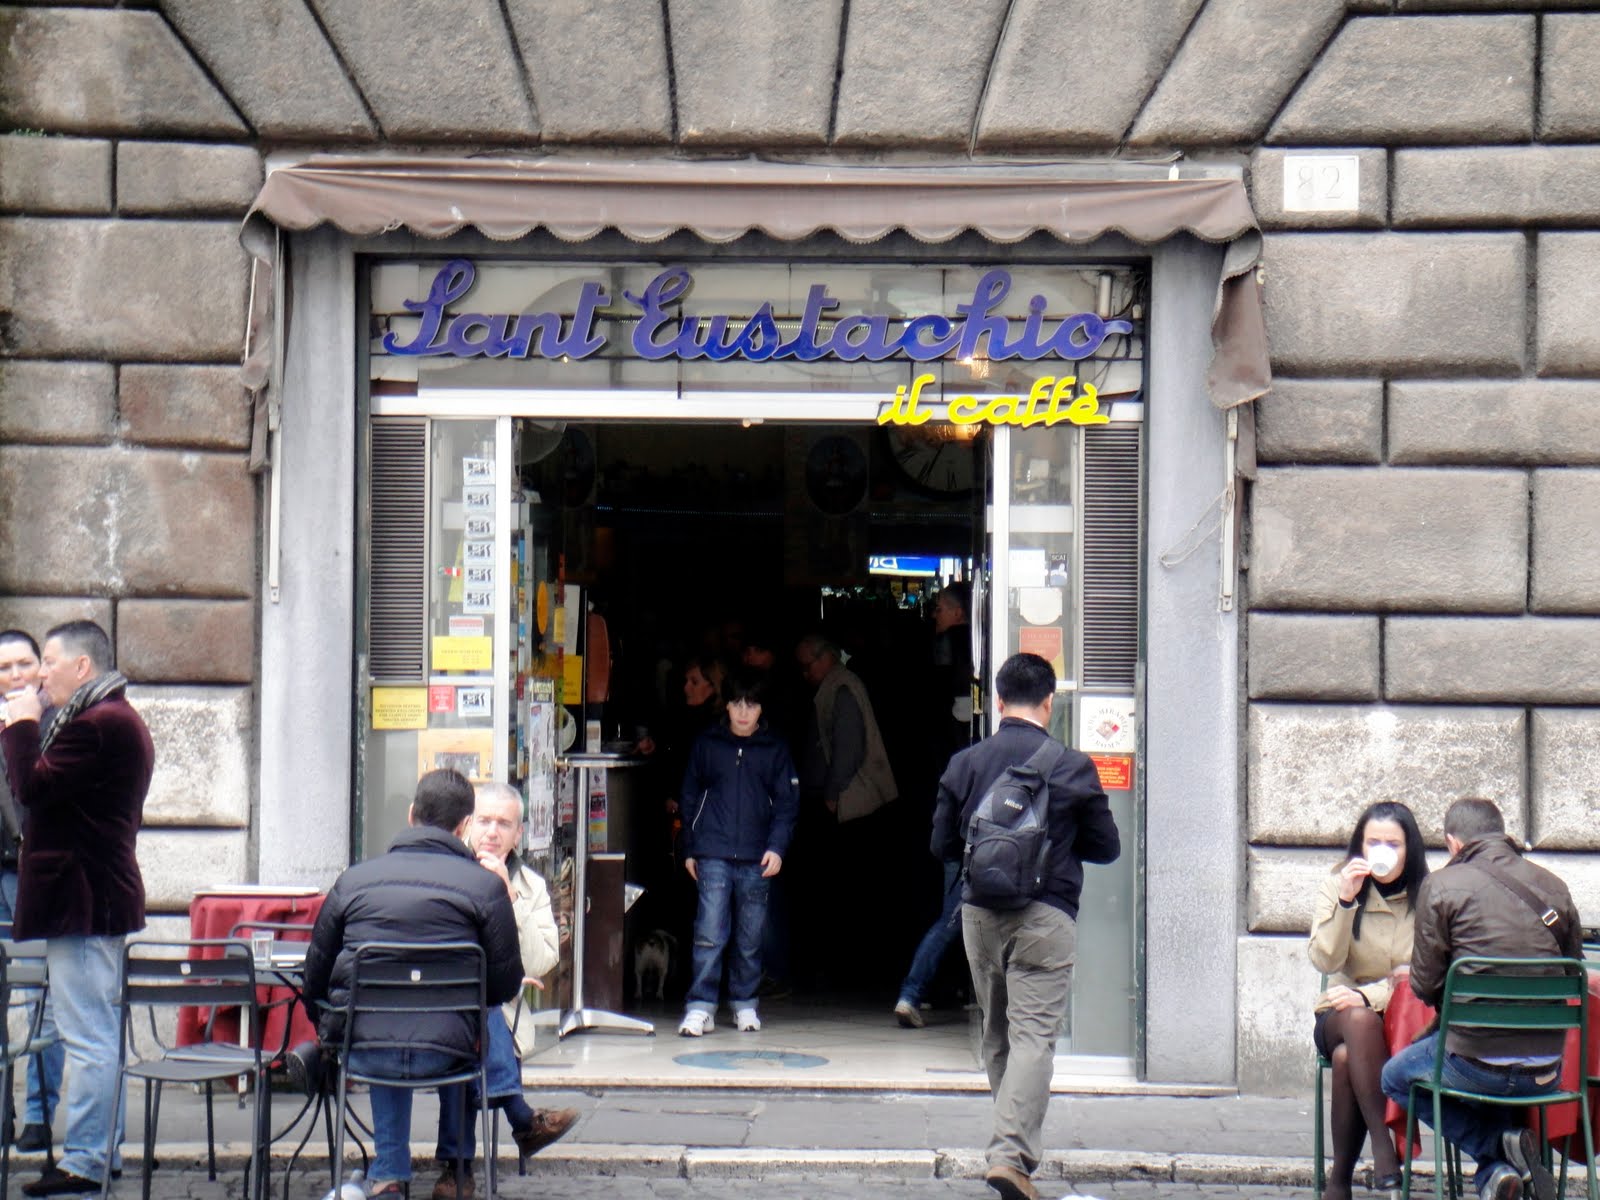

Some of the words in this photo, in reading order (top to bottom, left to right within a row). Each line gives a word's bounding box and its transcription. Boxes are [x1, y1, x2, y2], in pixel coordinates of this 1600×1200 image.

[1297, 165, 1345, 200] 82
[382, 259, 611, 359] Sant
[622, 266, 1132, 361] Eustachio
[876, 373, 935, 426] il
[946, 374, 1111, 427] caffè
